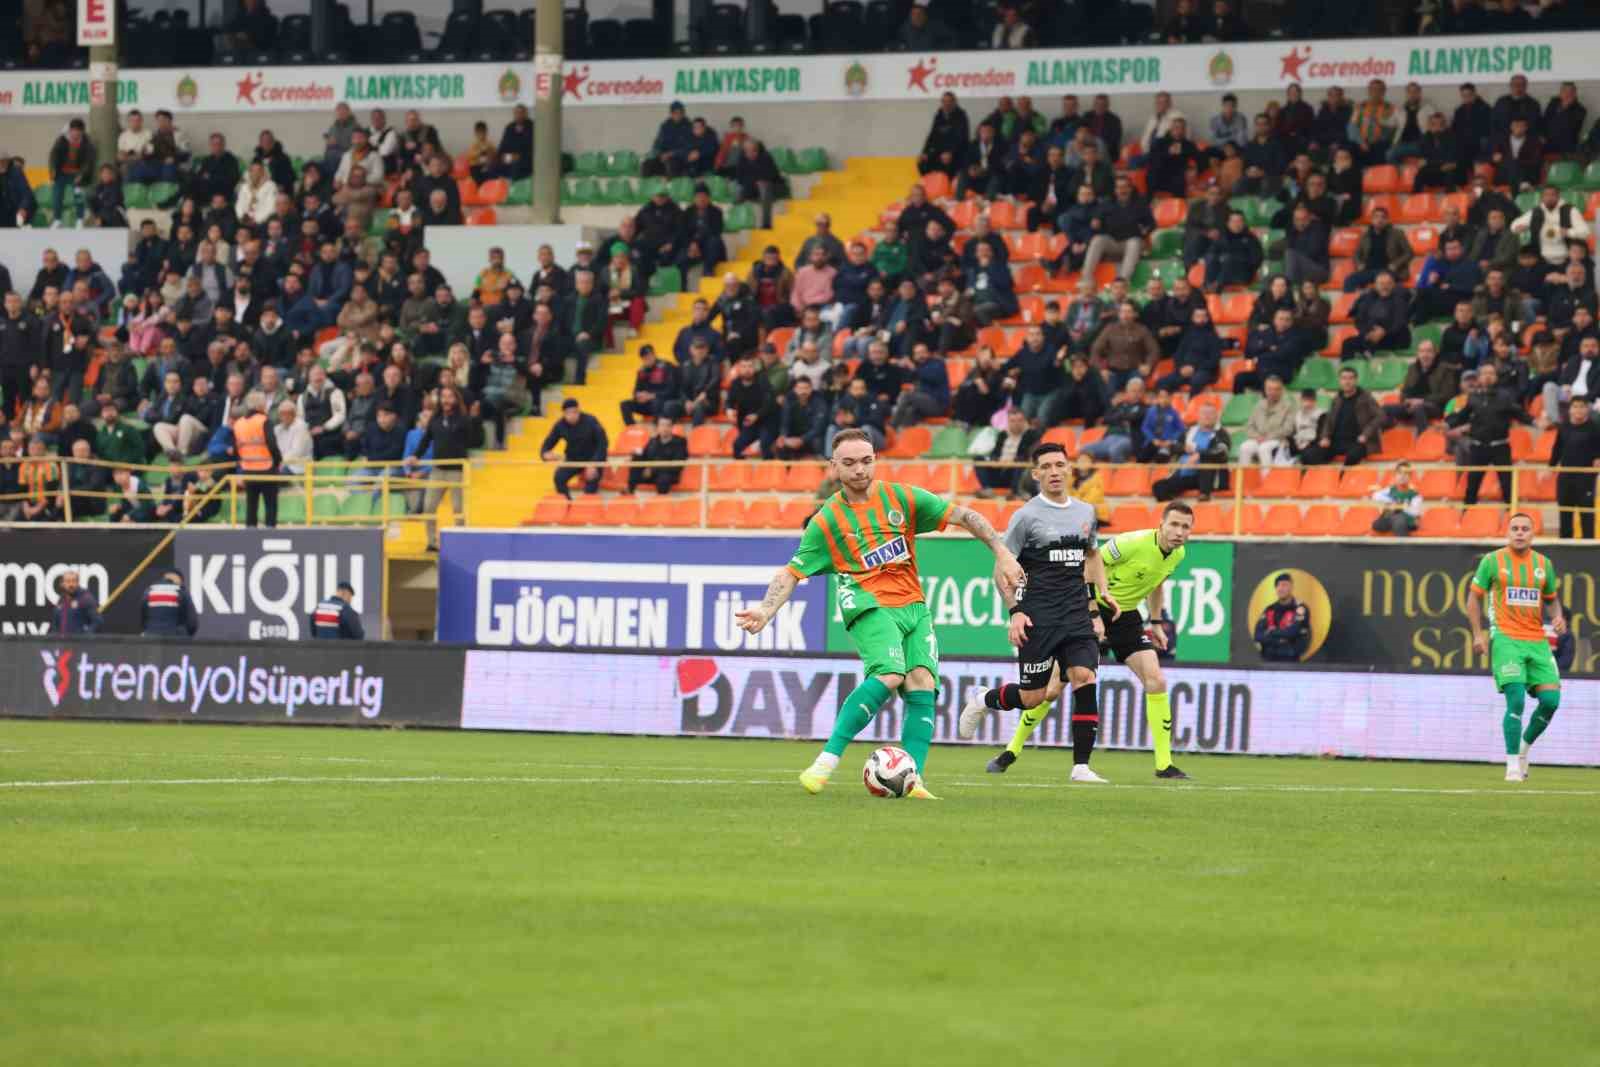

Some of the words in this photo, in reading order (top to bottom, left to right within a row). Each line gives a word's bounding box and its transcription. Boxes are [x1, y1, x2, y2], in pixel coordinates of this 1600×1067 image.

[86, 0, 105, 22] E
[933, 67, 1015, 88] corendon
[1026, 57, 1161, 86] ALANYASPOR
[1308, 57, 1395, 77] corendon
[1408, 45, 1552, 75] ALANYASPOR
[23, 80, 138, 105] ALANYAOR
[260, 81, 334, 101] corendon
[344, 74, 465, 100] ALANYASPOR
[587, 76, 664, 96] corendon
[674, 67, 800, 95] ALANYASPOR
[78, 654, 246, 713] trendyol
